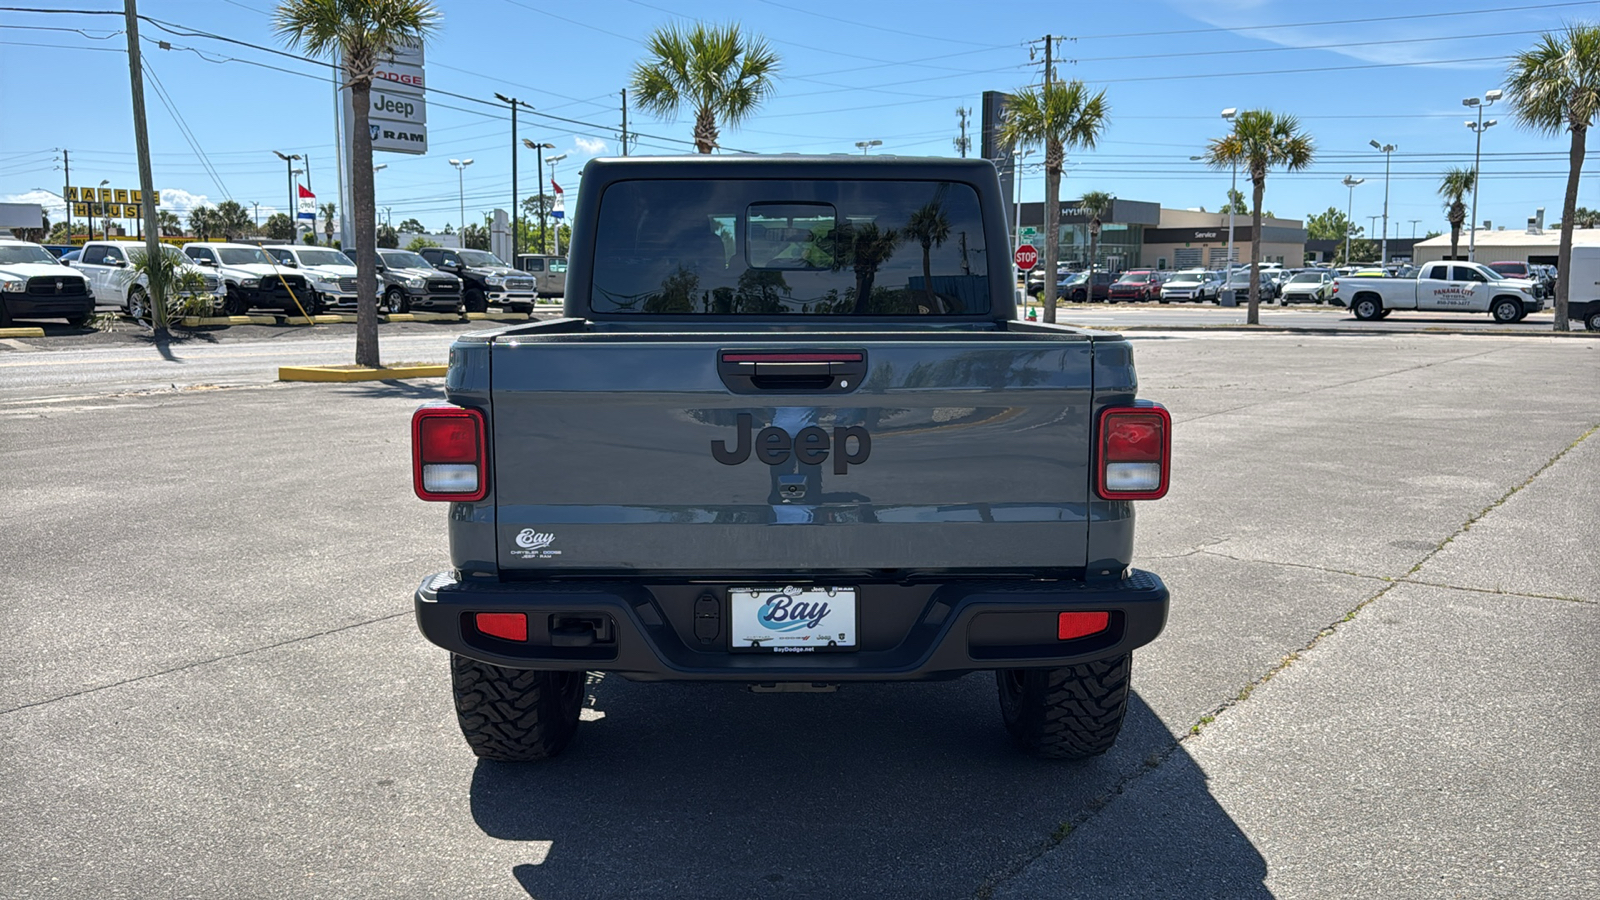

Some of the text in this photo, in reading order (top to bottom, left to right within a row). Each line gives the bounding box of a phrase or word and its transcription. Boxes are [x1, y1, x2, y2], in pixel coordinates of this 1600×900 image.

[375, 71, 422, 85] ODGE
[374, 95, 414, 118] Jeep
[383, 130, 424, 142] RAM
[1016, 252, 1037, 262] STOP
[1434, 288, 1475, 296] PANAMA CITY
[711, 413, 872, 475] Jeep
[516, 528, 556, 547] Bay
[763, 594, 831, 629] Bay
